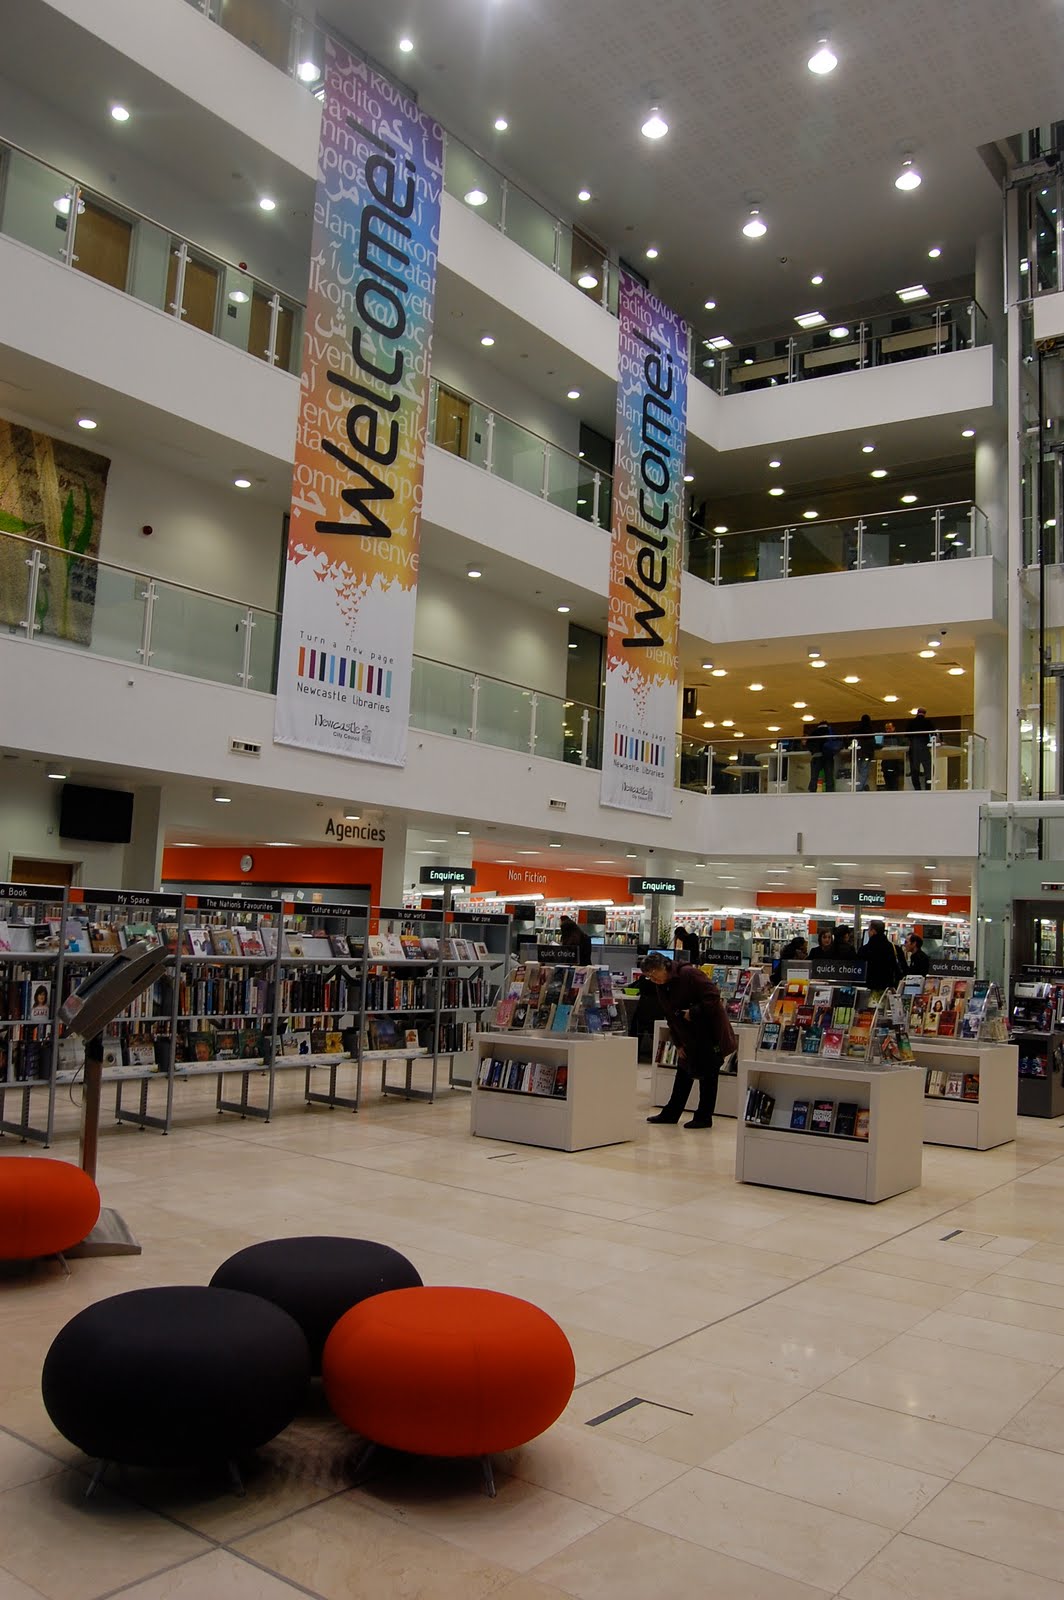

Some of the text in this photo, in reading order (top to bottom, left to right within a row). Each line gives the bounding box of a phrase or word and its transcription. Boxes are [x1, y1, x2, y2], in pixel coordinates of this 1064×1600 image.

[314, 114, 416, 539] Welcome!
[622, 327, 673, 649] Welcome!
[299, 630, 326, 645] Turn
[345, 644, 364, 656] new
[370, 652, 395, 665] page
[296, 681, 348, 703] Newcastle
[314, 713, 362, 735] Newcastle
[613, 758, 640, 774] Newcastle
[324, 817, 386, 843] Agencies
[429, 869, 466, 882] Enquiries
[507, 868, 547, 884] Non Fiction
[8, 887, 28, 898] Book
[641, 880, 677, 892] Enquiries
[117, 895, 151, 906] My Space
[206, 898, 218, 908] The
[243, 901, 274, 912] Favourites
[310, 905, 352, 916] Culture vulture
[413, 912, 427, 920] world
[540, 949, 576, 959] quick choice
[708, 953, 740, 962] quick choice
[816, 964, 863, 975] quick choice
[932, 962, 971, 973] quick choice
